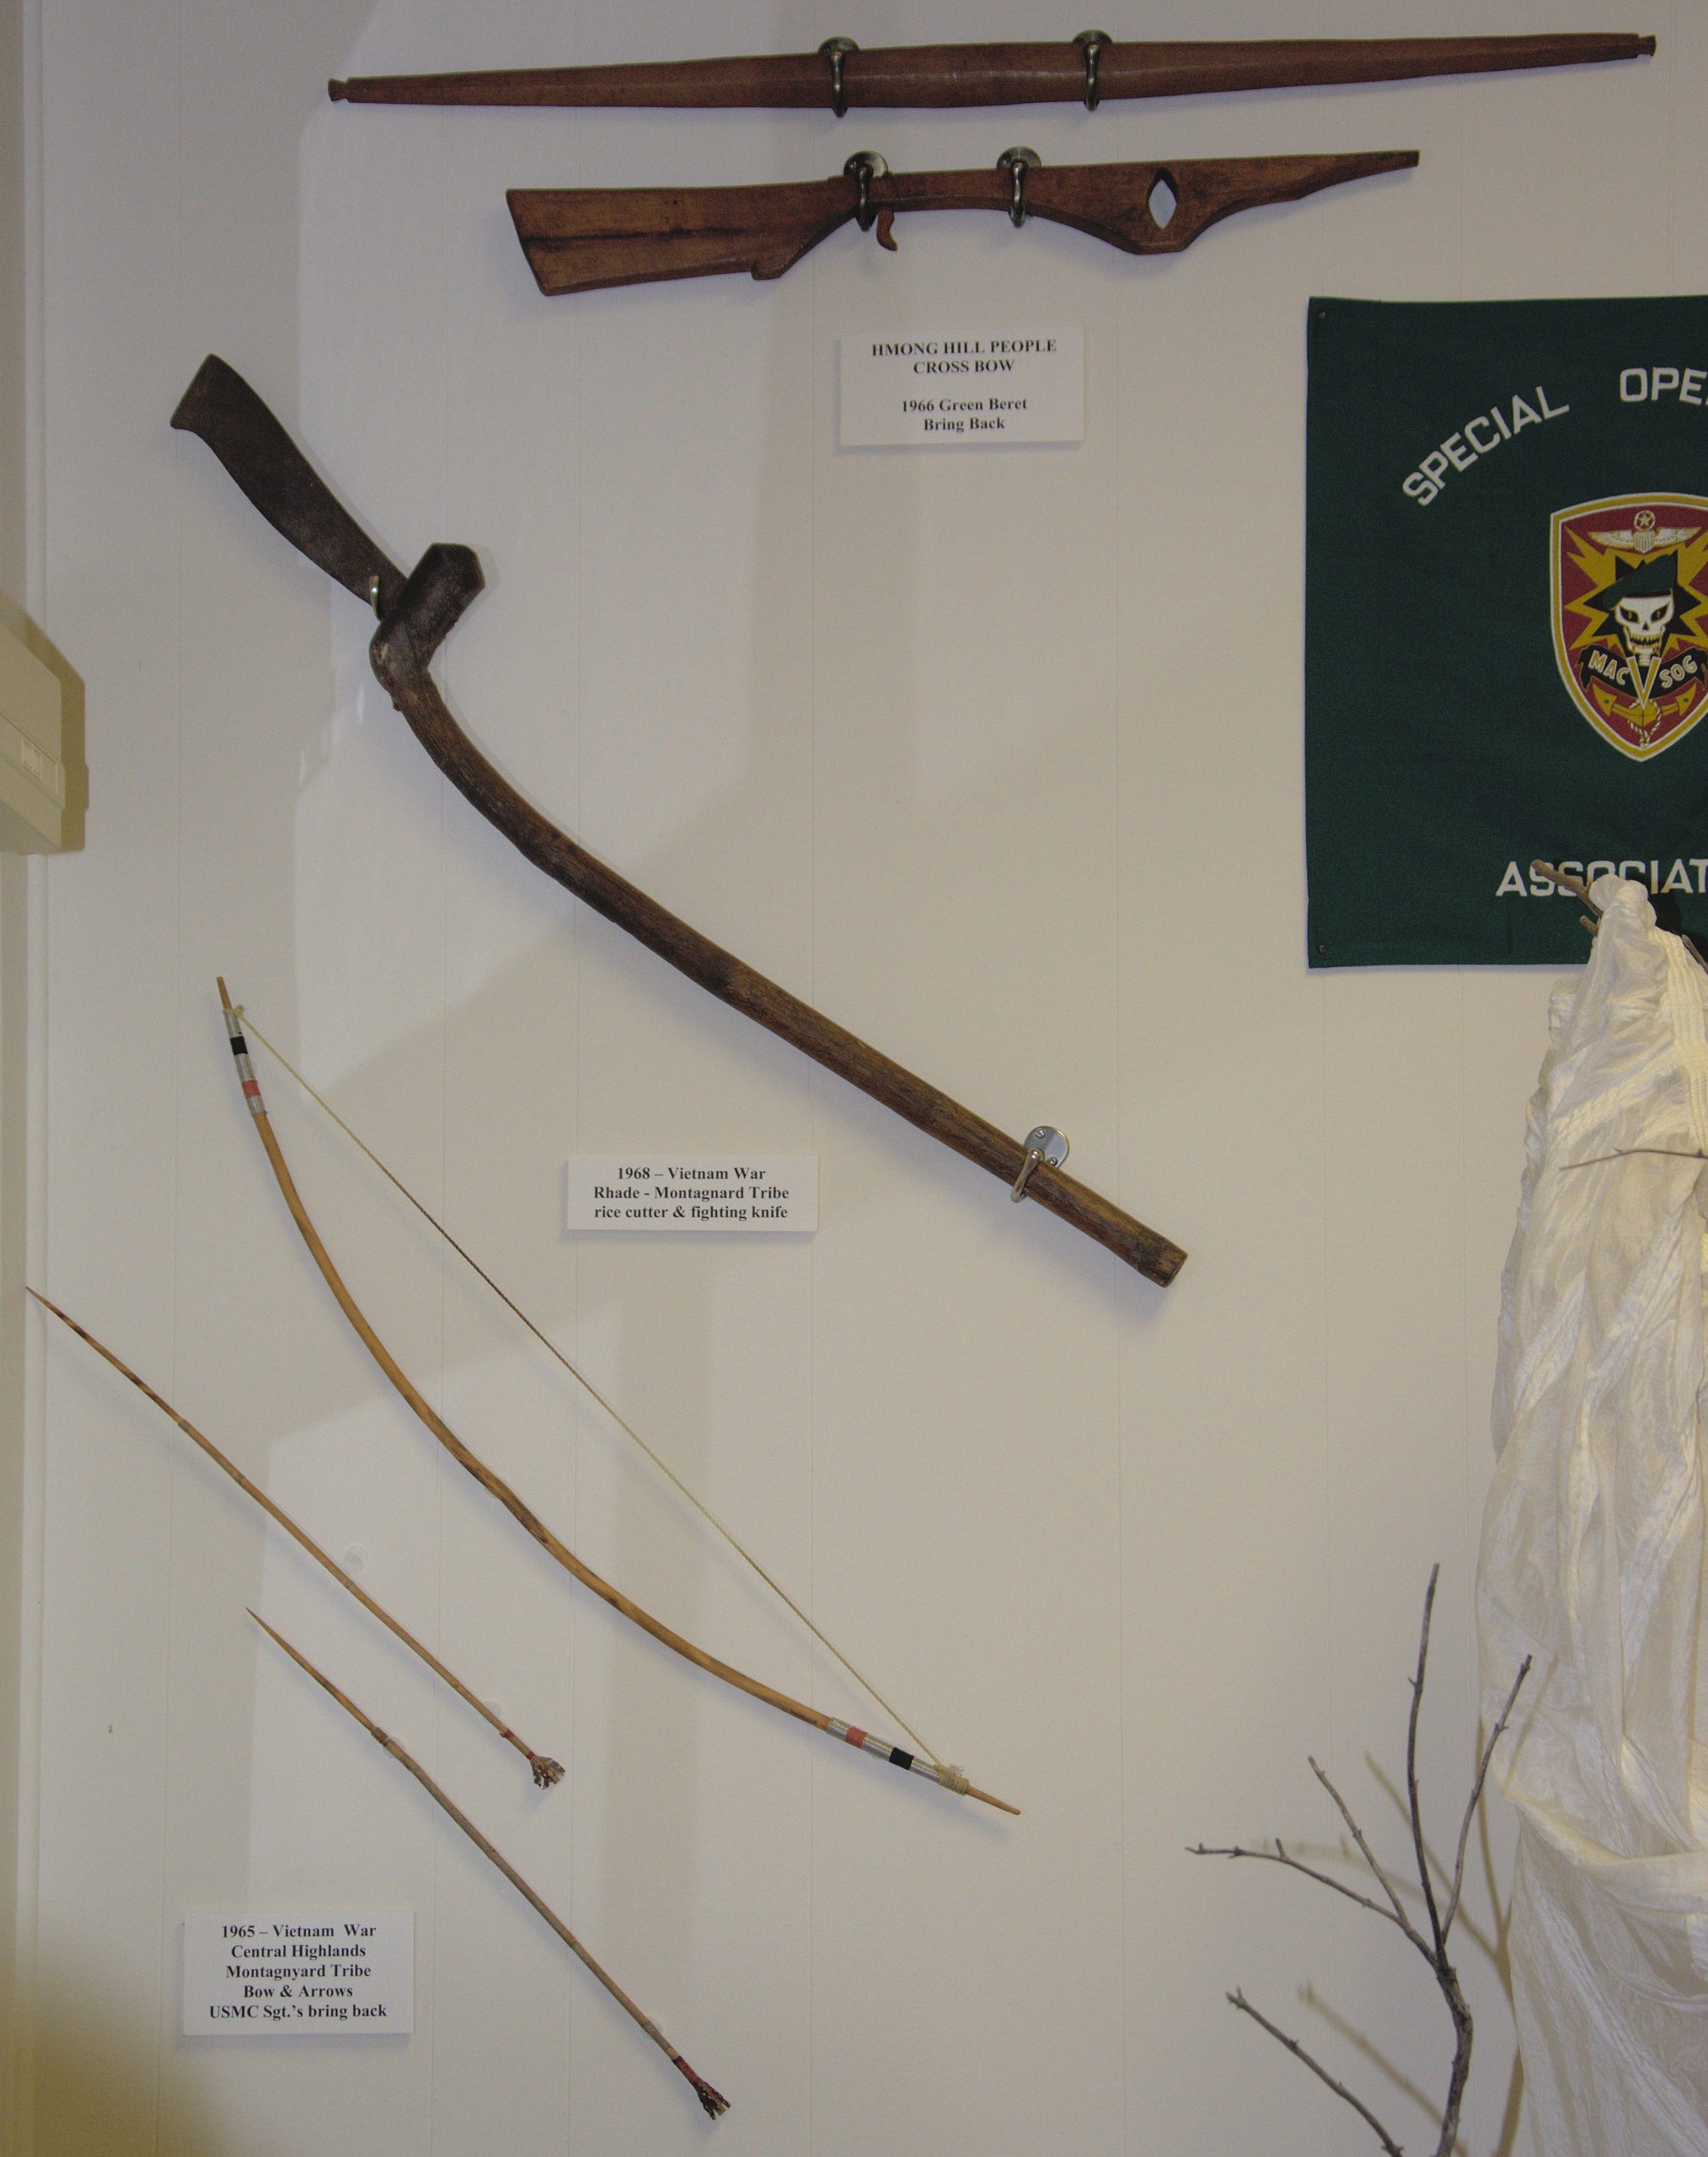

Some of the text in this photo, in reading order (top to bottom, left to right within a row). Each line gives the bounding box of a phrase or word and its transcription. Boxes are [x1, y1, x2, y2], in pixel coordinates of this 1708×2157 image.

[871, 339, 1057, 357] HMONG HILL PEOPLE
[913, 359, 1015, 374] CROSS BOW
[902, 398, 1027, 413] 1966 Green Beret
[924, 416, 1005, 433] Bring Back
[1401, 367, 1708, 506] SPECIAL OPE
[1588, 650, 1630, 686] MAC
[1659, 655, 1698, 689] SOG
[618, 1167, 651, 1180] 1968
[667, 1166, 729, 1180] Vietnam
[733, 1167, 767, 1180] War
[593, 1186, 640, 1200] Rhade
[654, 1186, 745, 1202] Montagnard
[748, 1186, 790, 1200] Tribe
[594, 1205, 789, 1222] rice cutter & fighting knife
[222, 1924, 255, 1939] 1965
[272, 1924, 335, 1938] Vietnam
[343, 1924, 377, 1937] War
[230, 1943, 367, 1961] Central Highlands
[226, 1963, 372, 1982] Montagnyard Tribe
[244, 1984, 354, 1999] Bow & Arrows
[209, 2004, 260, 2019] USMC
[308, 2004, 348, 2021] bring
[352, 2004, 388, 2017] back
